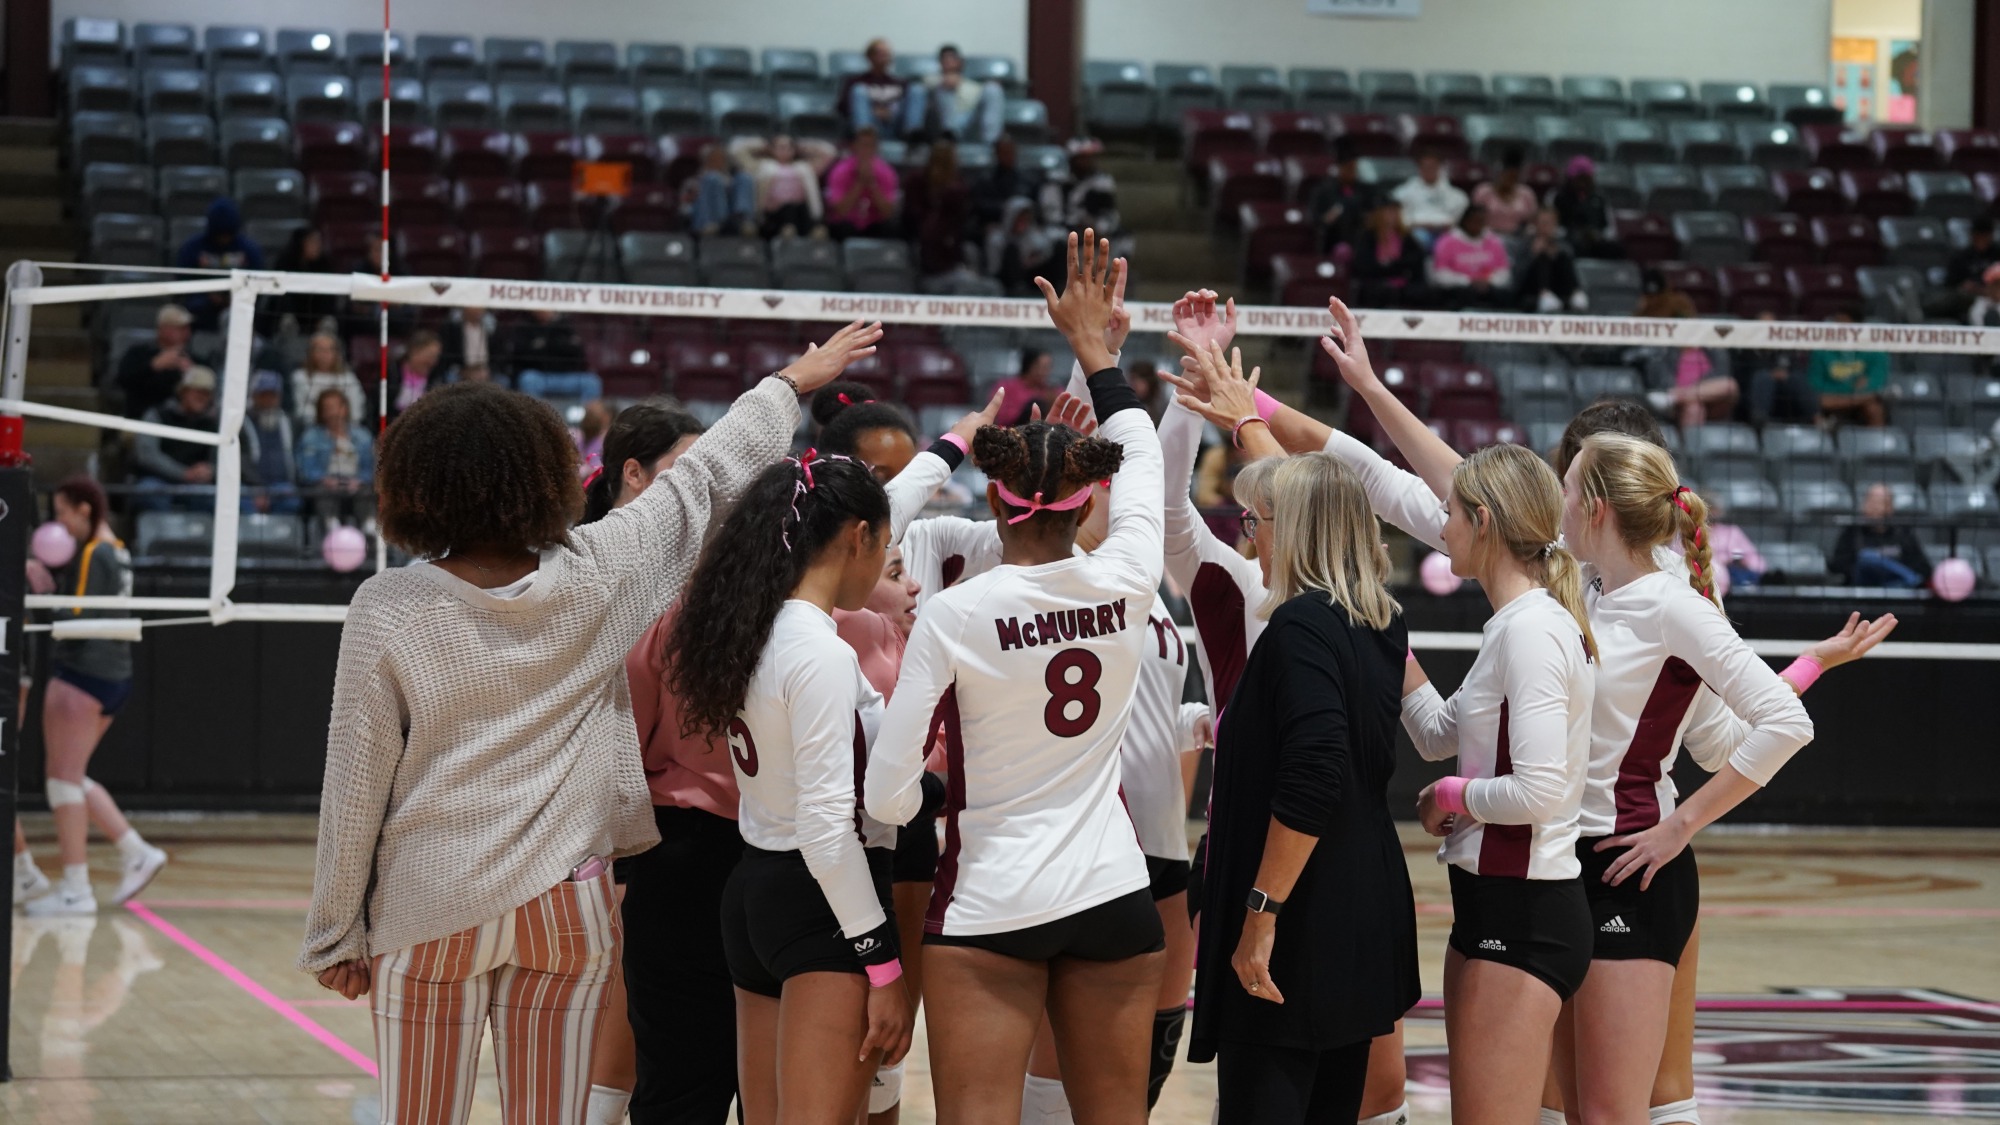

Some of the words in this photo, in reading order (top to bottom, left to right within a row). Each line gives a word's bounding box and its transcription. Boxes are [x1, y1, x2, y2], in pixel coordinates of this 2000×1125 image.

[599, 288, 725, 308] UNIVERSITY
[926, 301, 1049, 320] UNIVERSITY
[1560, 320, 1679, 338] UNIVERSITY
[1869, 328, 1985, 346] UNIVERSITY
[1044, 647, 1102, 738] 8
[1600, 924, 1631, 933] adidas
[1478, 941, 1507, 951] adidas
